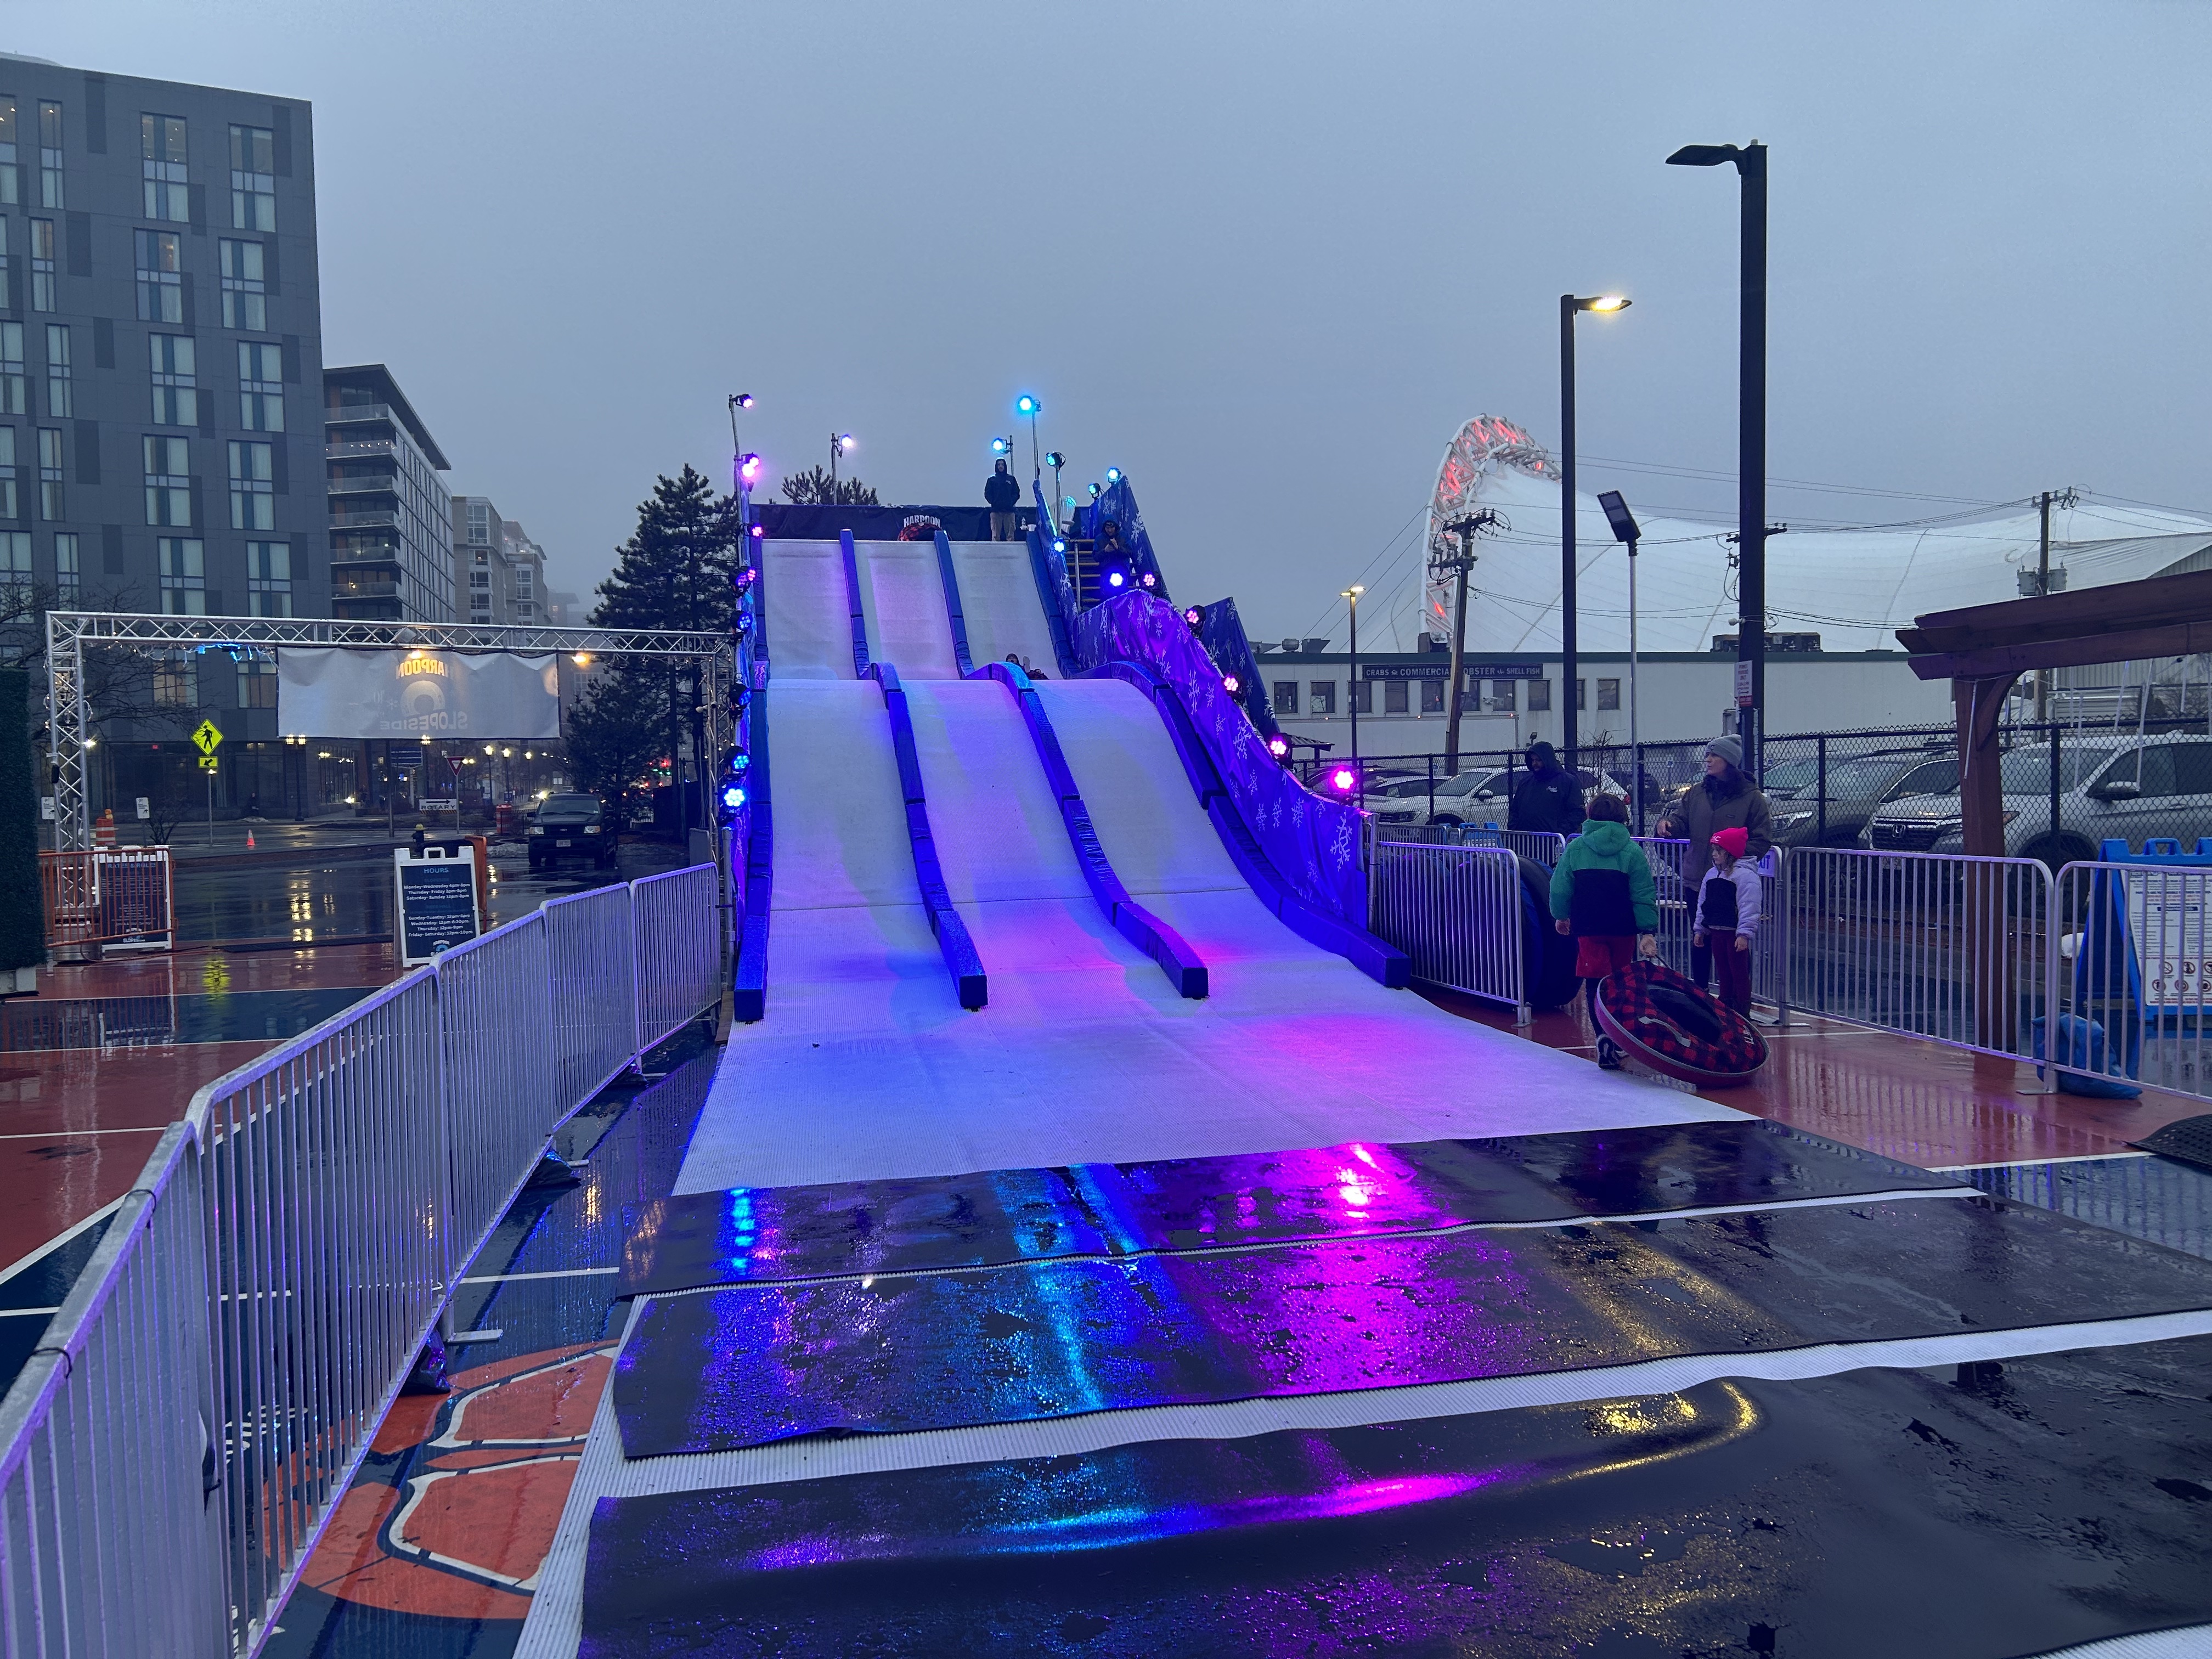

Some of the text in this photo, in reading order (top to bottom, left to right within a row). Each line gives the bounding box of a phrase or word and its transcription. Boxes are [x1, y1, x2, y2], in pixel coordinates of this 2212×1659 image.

[904, 515, 941, 528] HARPOON
[1400, 668, 1450, 676] COMMERCIA
[1463, 667, 1496, 675] OBSTER
